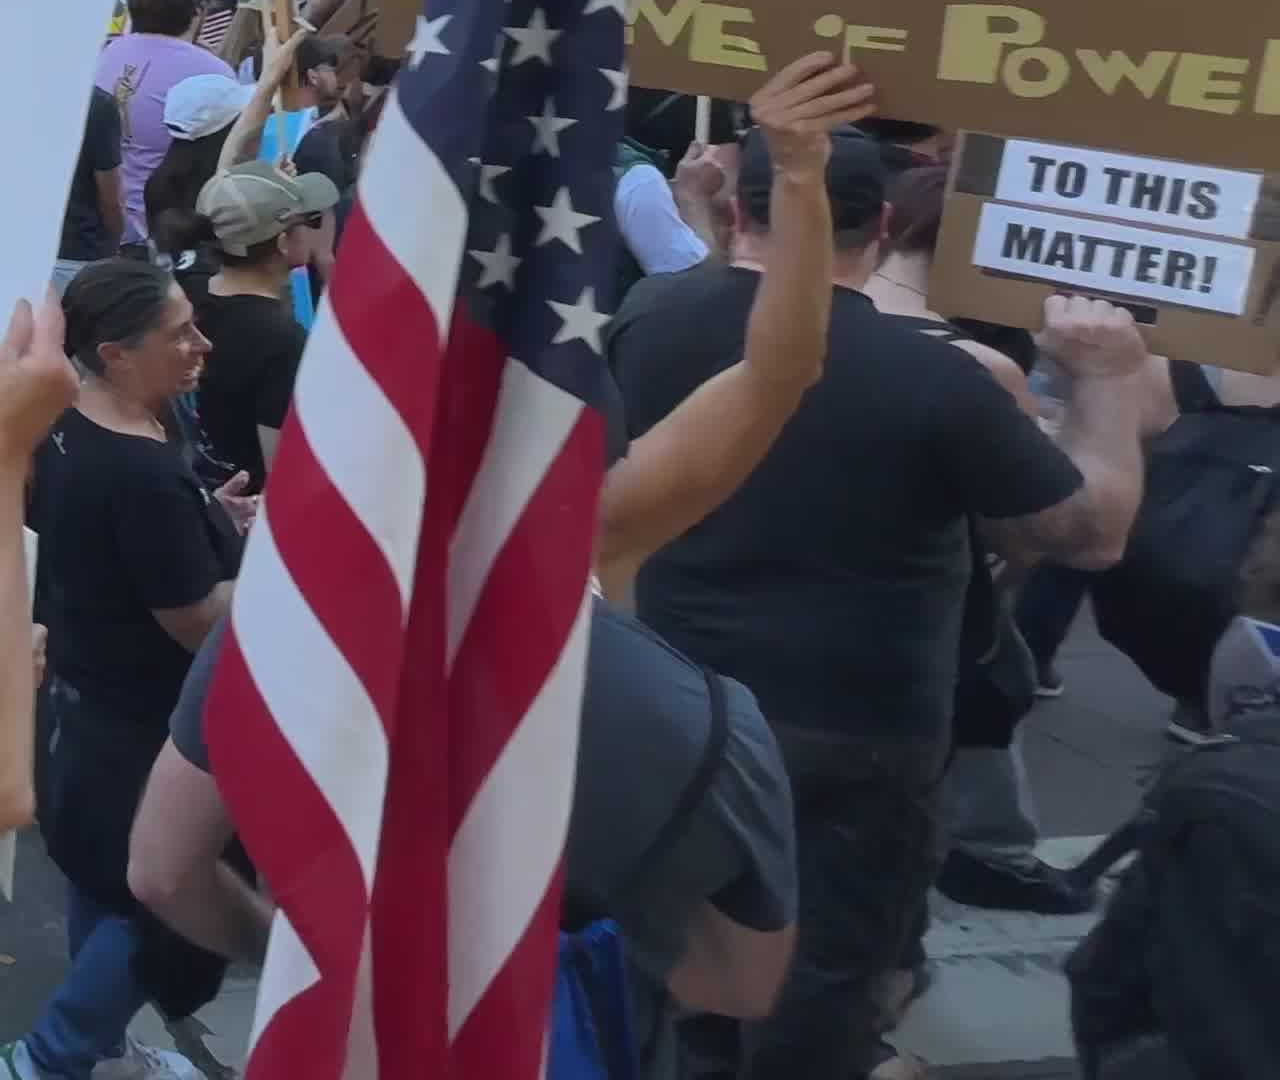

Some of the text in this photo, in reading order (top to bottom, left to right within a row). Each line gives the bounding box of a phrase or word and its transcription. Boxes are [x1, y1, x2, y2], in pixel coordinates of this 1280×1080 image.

[1027, 155, 1222, 221] TO THIS
[1000, 222, 1218, 294] MATTER!
